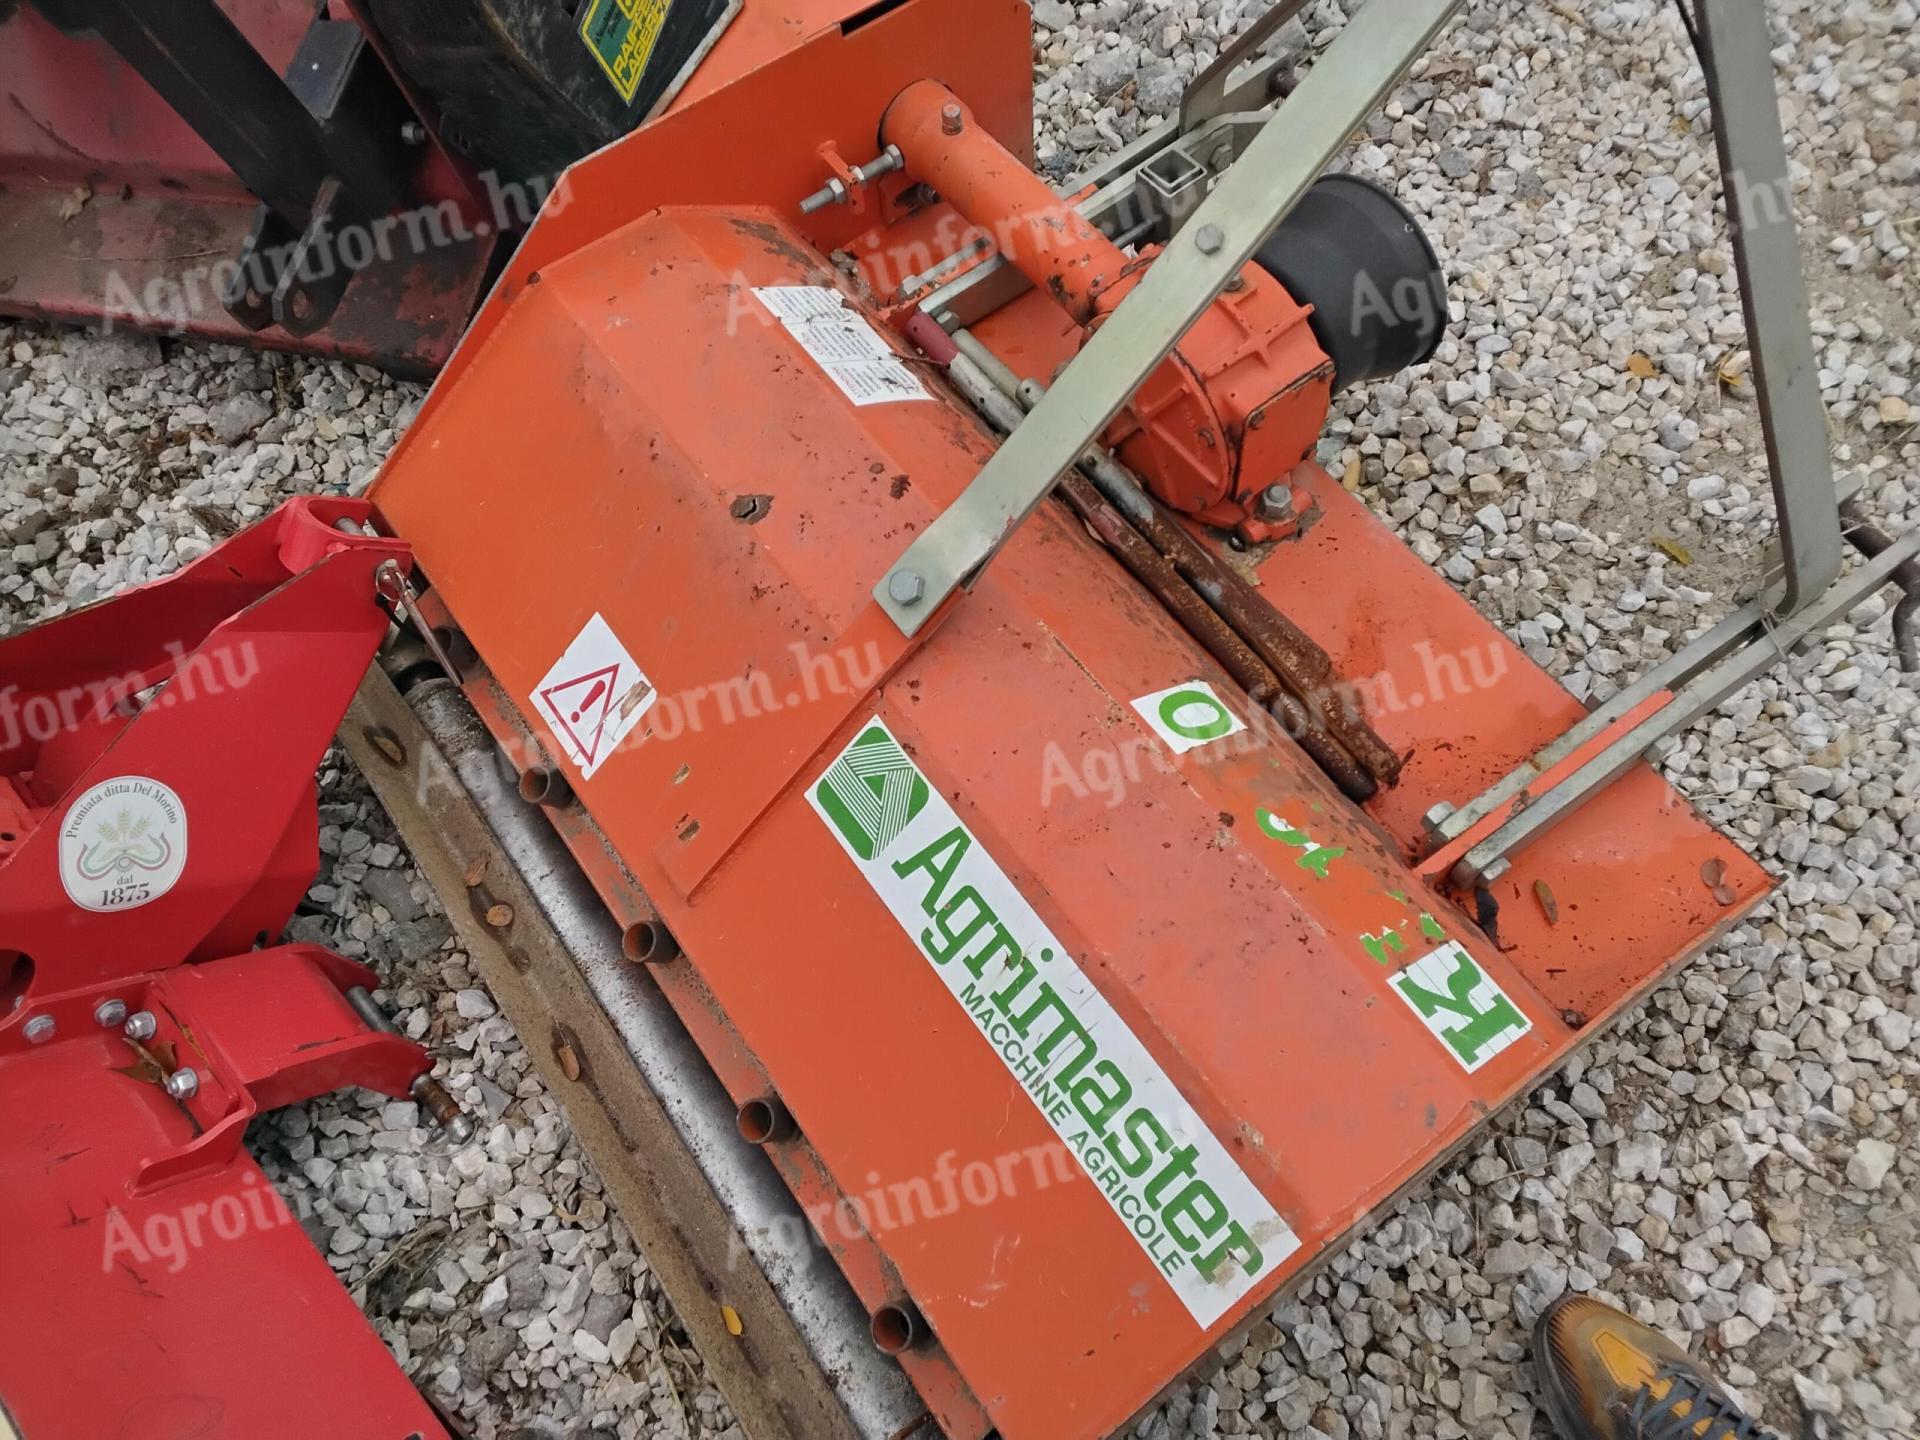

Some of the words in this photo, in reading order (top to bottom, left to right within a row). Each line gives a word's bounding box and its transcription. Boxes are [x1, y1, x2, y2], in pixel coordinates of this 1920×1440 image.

[65, 794, 103, 838] Premiata
[104, 784, 130, 797] ditta
[133, 782, 152, 795] Del
[152, 789, 178, 824] Morino
[98, 882, 150, 907] 1875
[116, 874, 133, 886] dal
[892, 825, 1264, 1284] Agrimaster
[958, 982, 1071, 1127] MACCHINE
[1066, 1129, 1188, 1280] AGRICOLE
